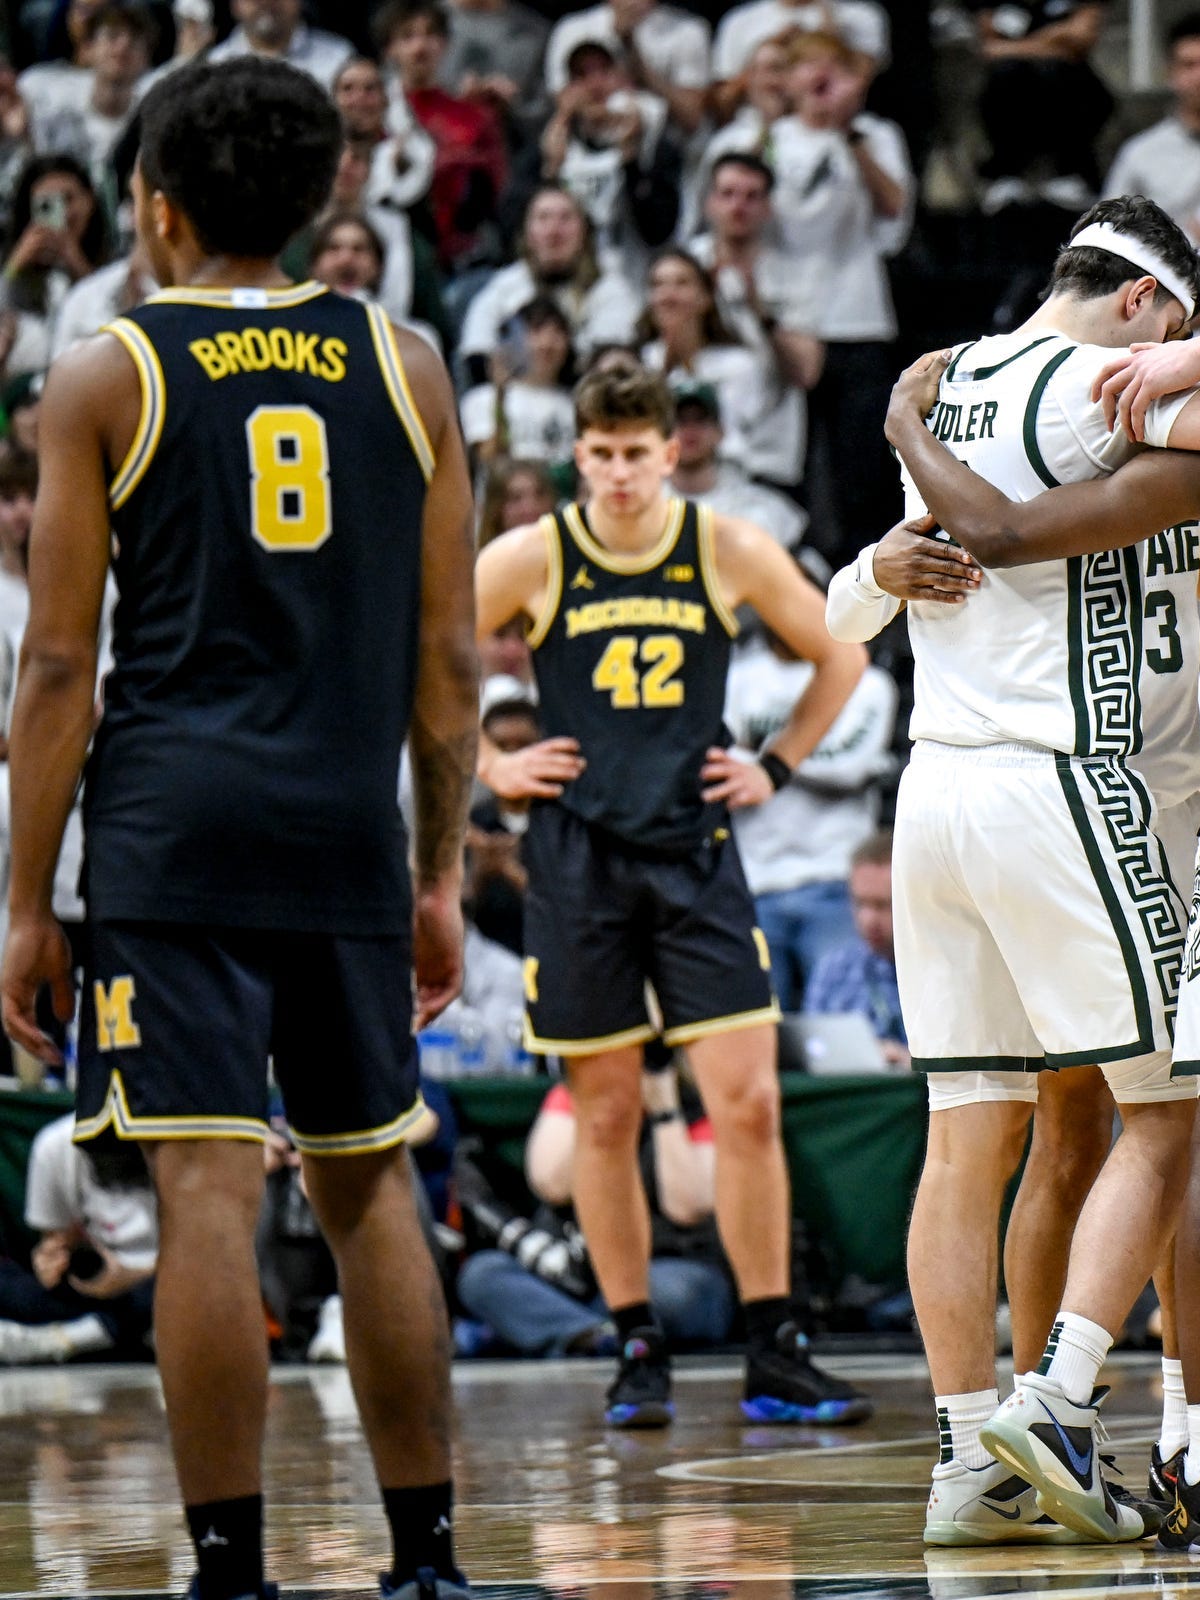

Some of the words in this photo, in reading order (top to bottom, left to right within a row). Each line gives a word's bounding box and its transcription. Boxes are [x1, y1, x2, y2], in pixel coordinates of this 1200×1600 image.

[188, 326, 349, 382] BROOKS
[245, 404, 333, 552] 8
[1146, 520, 1200, 578] ATE
[565, 596, 706, 640] MICHIGAN
[1144, 590, 1184, 674] 3
[592, 633, 685, 710] 42
[93, 974, 142, 1053] M
